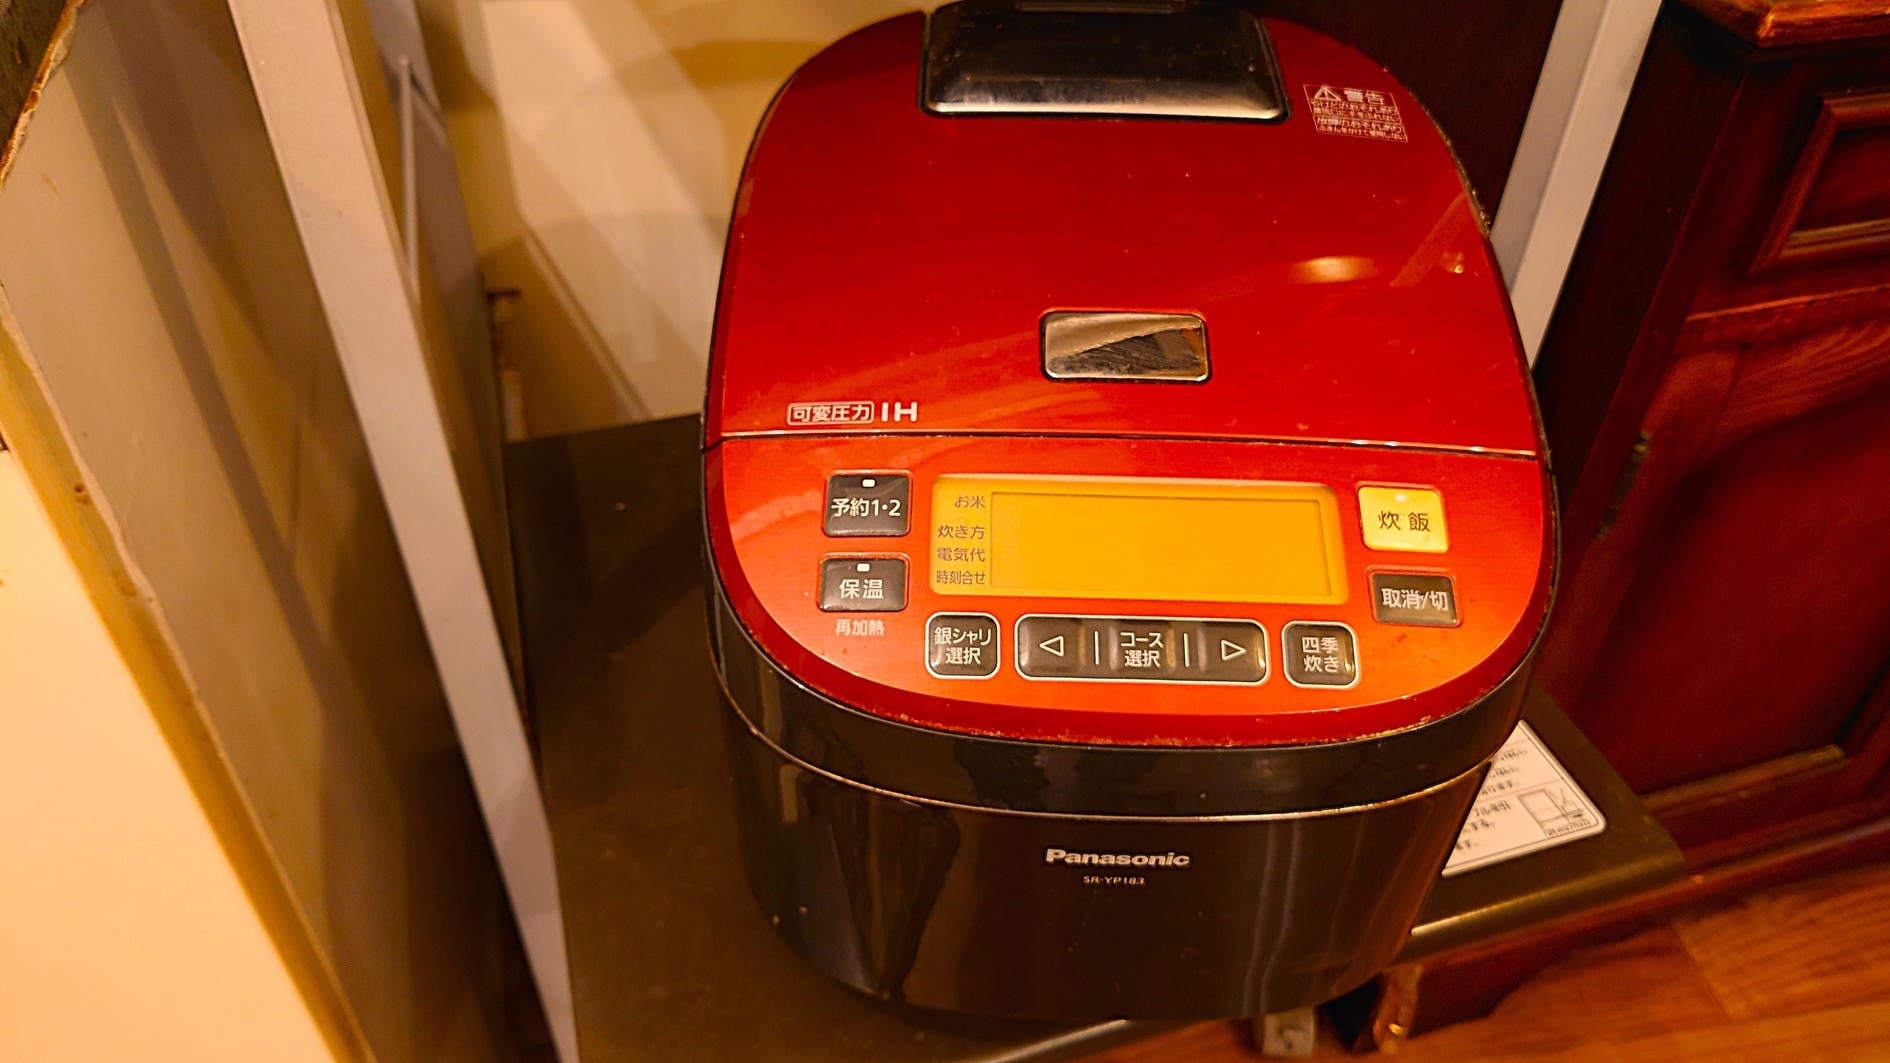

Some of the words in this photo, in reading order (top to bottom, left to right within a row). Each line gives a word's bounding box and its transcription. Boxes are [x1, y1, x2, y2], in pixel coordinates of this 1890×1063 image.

[792, 403, 870, 423] 可変圧力
[880, 401, 918, 422] IH
[954, 495, 985, 509] お米
[937, 524, 985, 540] 炊き方
[936, 547, 986, 562] 電気代
[936, 570, 986, 586] 時刻合せ
[839, 579, 884, 600] 保温
[1381, 588, 1449, 611] 取消/切
[835, 619, 885, 637] 再加熱
[934, 626, 992, 646] 銀シャリ
[1120, 631, 1164, 648] コース
[1302, 636, 1338, 654] 四季
[945, 647, 981, 665] 選択
[1124, 649, 1161, 669] 選択
[1303, 656, 1339, 674] 炊き
[1045, 848, 1191, 867] Panasonic
[1083, 875, 1145, 886] SR-YP183
